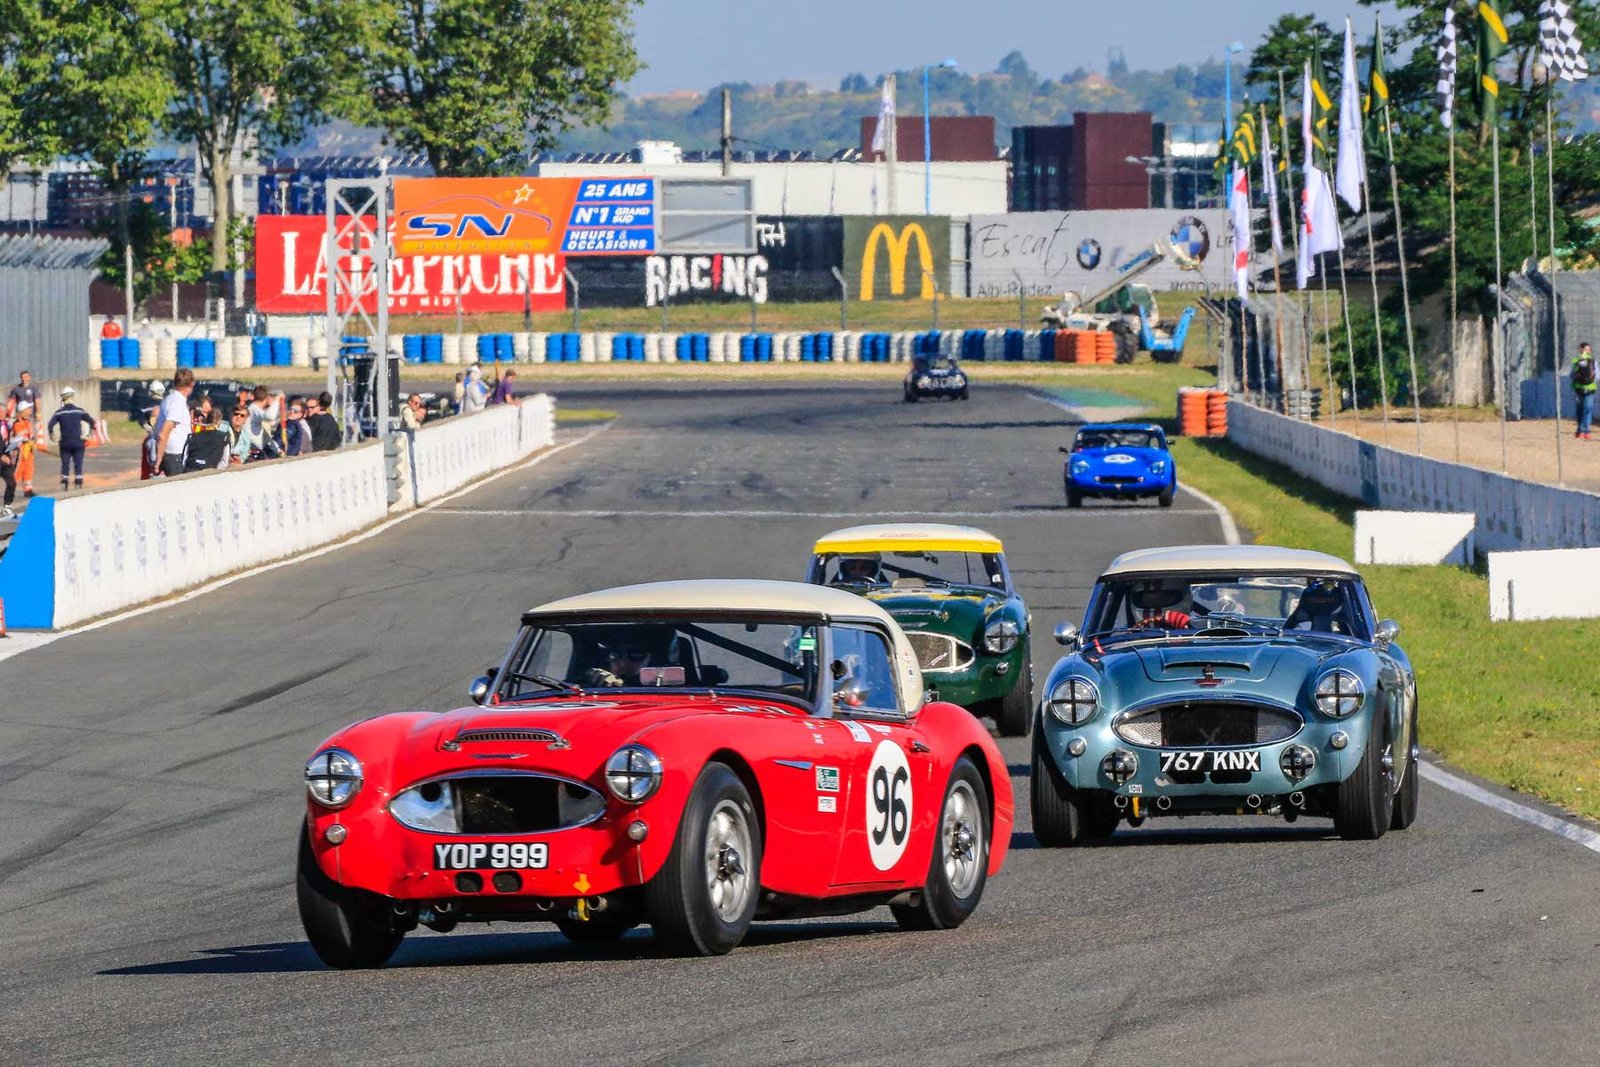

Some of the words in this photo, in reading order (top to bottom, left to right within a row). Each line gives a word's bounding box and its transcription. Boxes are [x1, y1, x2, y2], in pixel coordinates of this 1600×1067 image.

[583, 184, 607, 198] 25
[608, 183, 648, 197] ANS
[575, 207, 610, 223] N°1
[612, 215, 634, 223] SUD
[614, 207, 651, 215] GRAND
[403, 213, 517, 239] SN
[570, 230, 615, 241] NEUFS
[619, 230, 628, 240] &
[567, 239, 648, 251] OCCASIONS
[645, 252, 769, 307] RACING
[1160, 752, 1205, 772] 767
[1212, 751, 1260, 771] KNX
[872, 765, 909, 846] 96
[435, 843, 488, 869] YOP
[490, 843, 549, 869] 999
